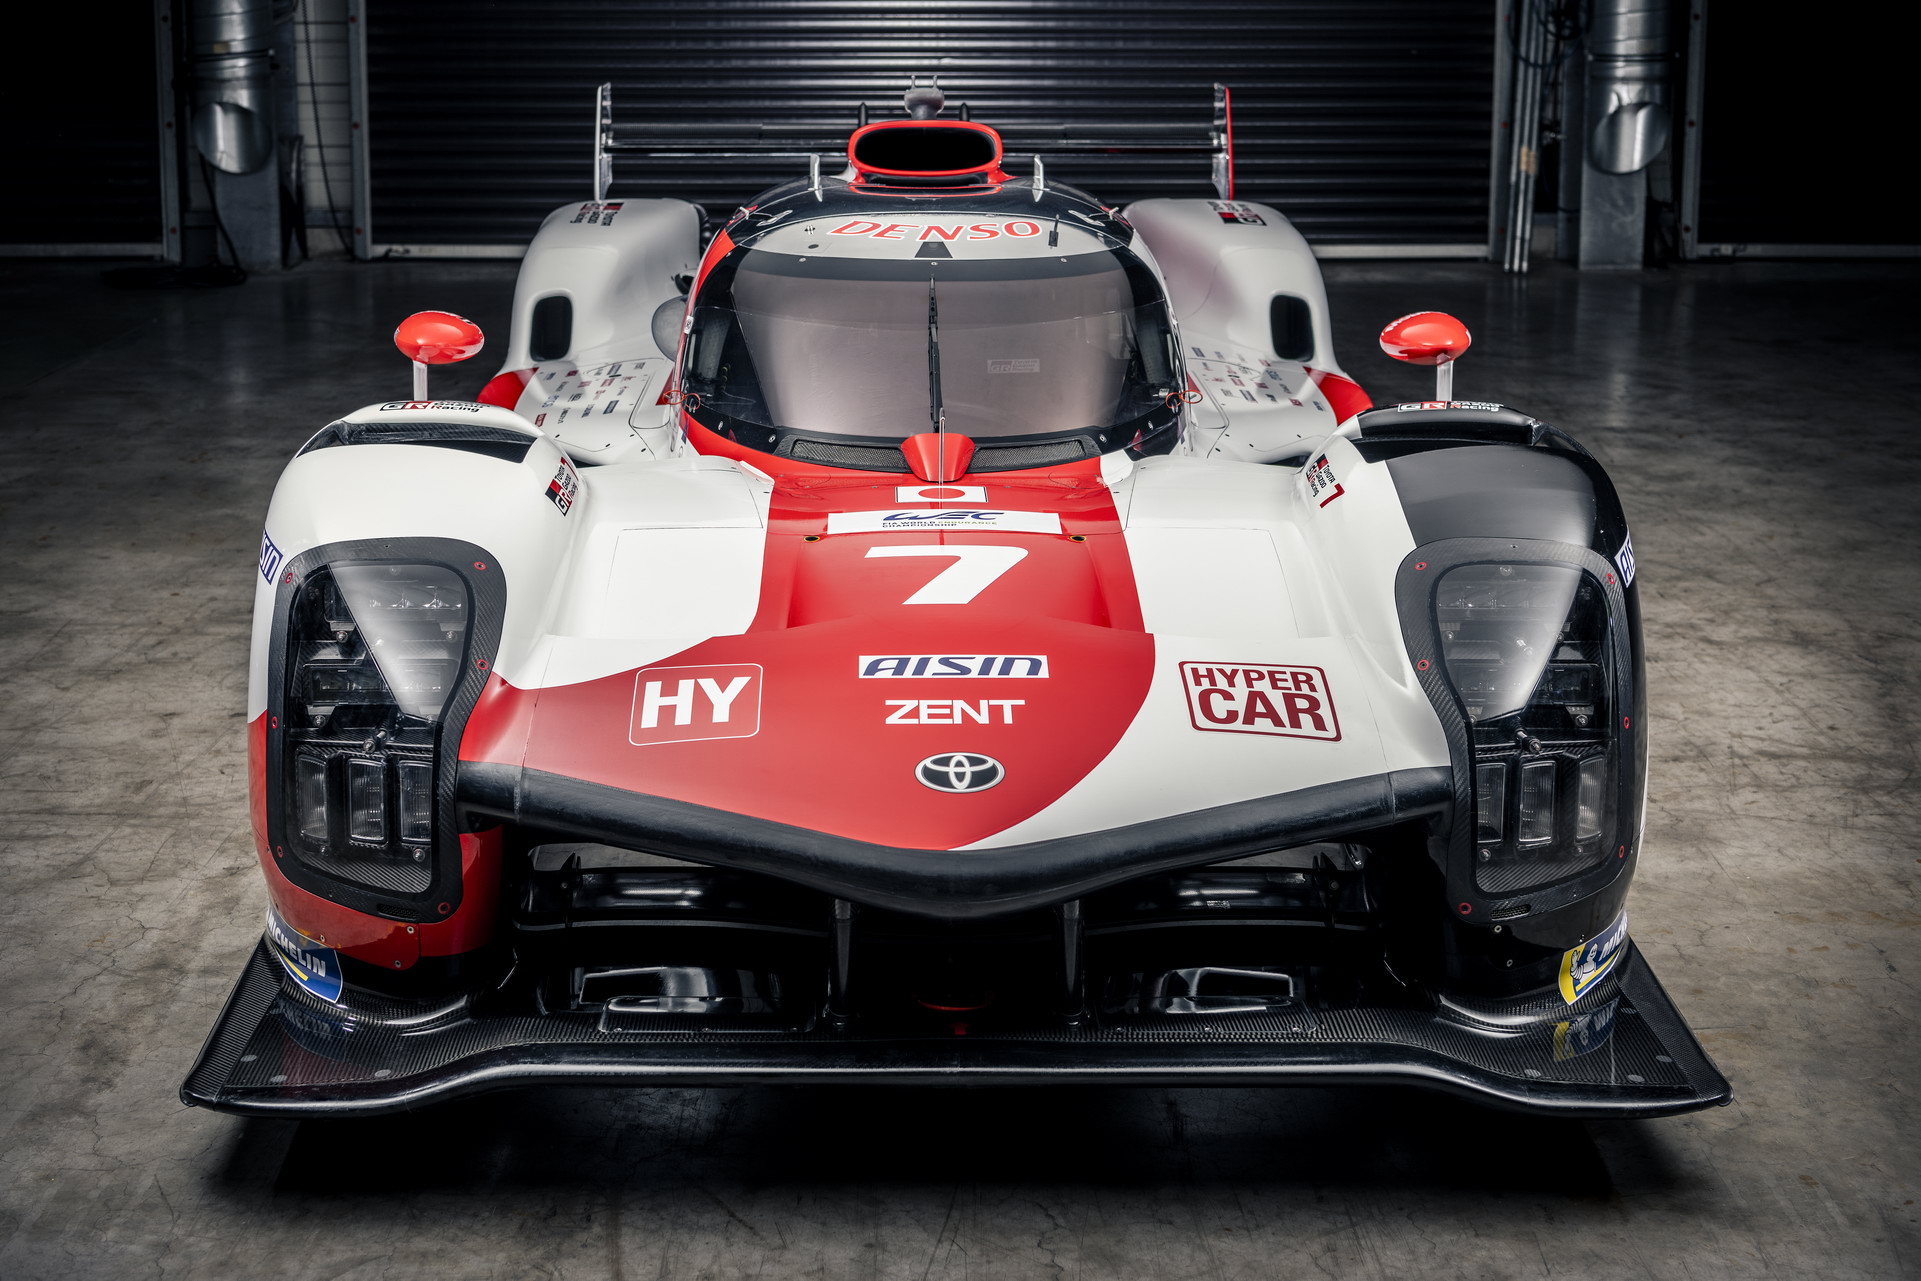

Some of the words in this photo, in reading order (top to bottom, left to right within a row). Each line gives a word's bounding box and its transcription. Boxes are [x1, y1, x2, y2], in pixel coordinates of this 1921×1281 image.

[828, 220, 1042, 241] DENSO
[382, 402, 430, 411] GR
[1400, 402, 1446, 411] GR
[555, 488, 571, 511] GR
[1319, 483, 1345, 508] 7
[883, 511, 1004, 521] WEC
[864, 545, 1028, 604] 7
[863, 657, 1043, 677] AISIN
[1191, 667, 1318, 692] HYPER
[641, 676, 752, 728] HY
[885, 700, 1025, 724] ZENT
[1198, 688, 1329, 732] CAR
[268, 911, 326, 977] MICHELIN
